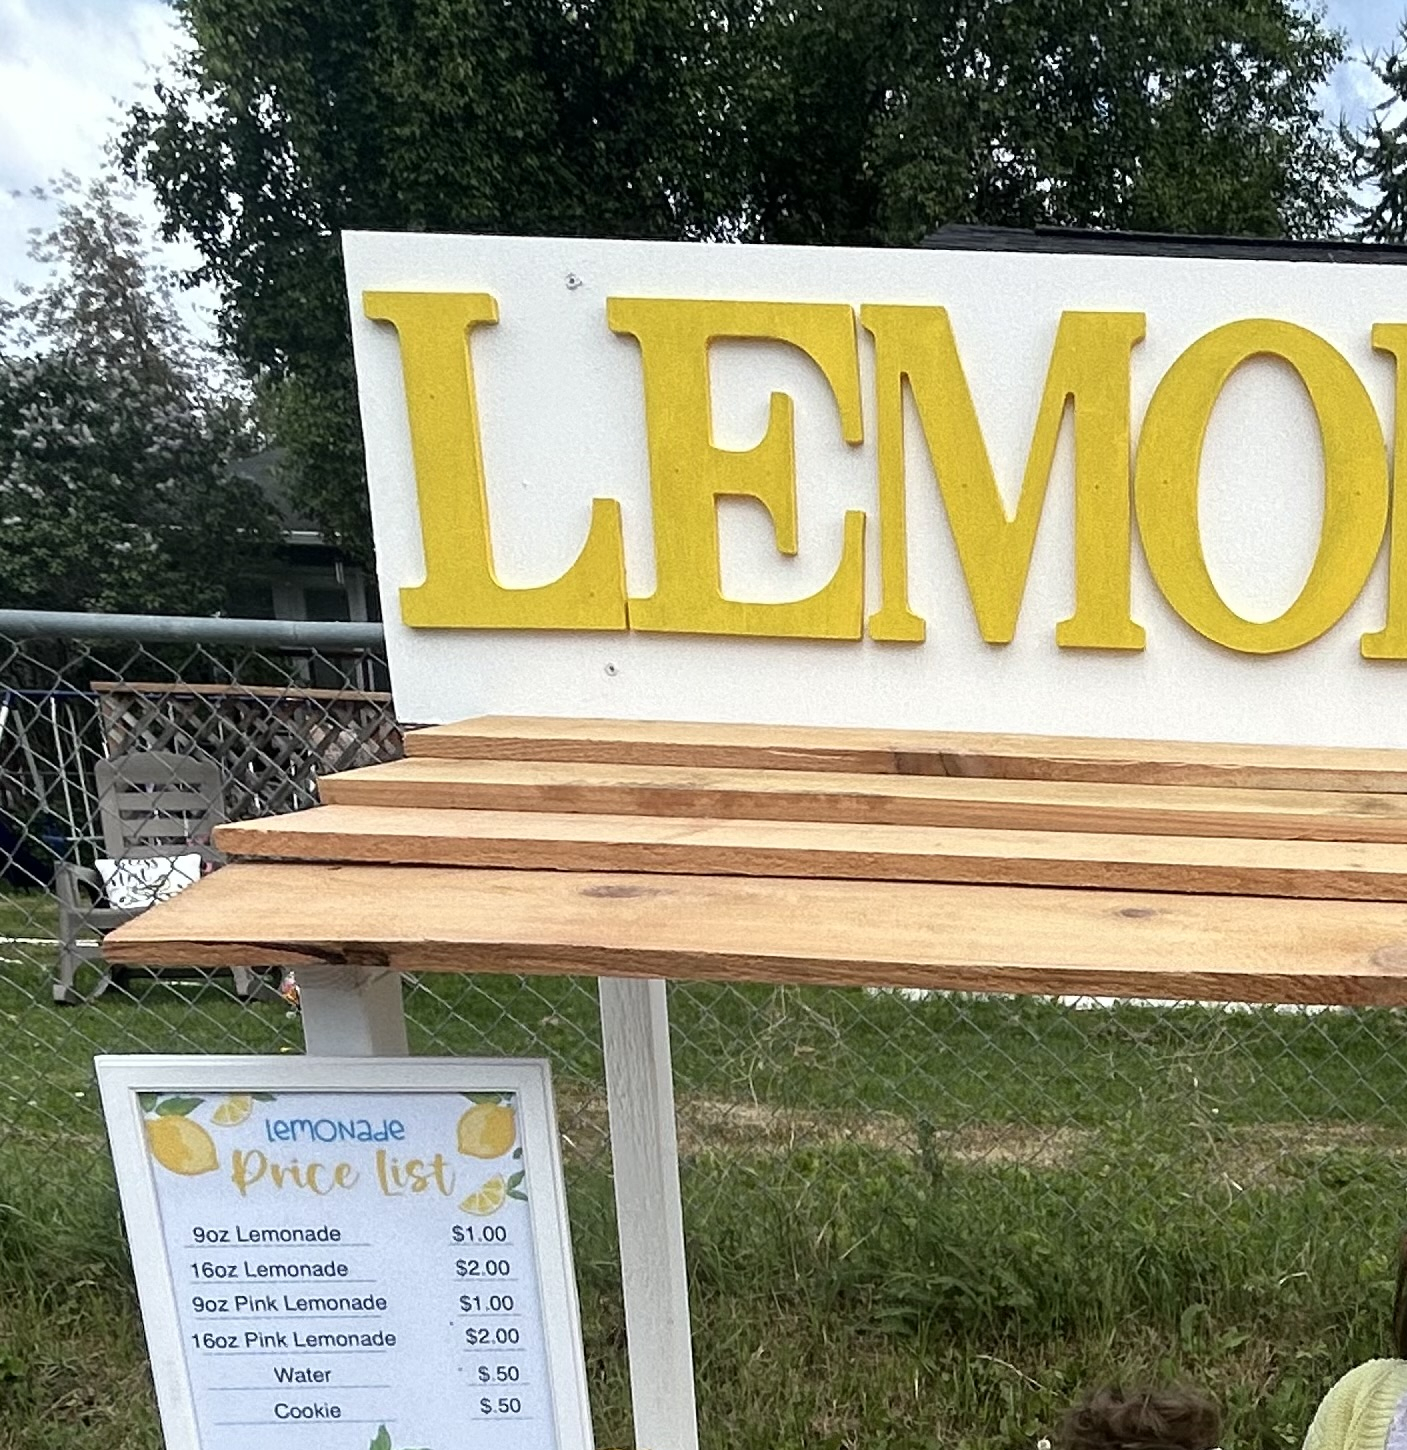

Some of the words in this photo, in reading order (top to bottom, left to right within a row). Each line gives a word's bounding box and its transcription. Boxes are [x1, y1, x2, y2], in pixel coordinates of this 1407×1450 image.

[231, 1149, 360, 1197] Price
[192, 1226, 231, 1243] 9oz
[236, 1224, 342, 1243] Lemonade
[451, 1224, 507, 1243] $1.00
[190, 1261, 239, 1279] 16oz
[243, 1260, 349, 1278] Lemonade
[455, 1258, 511, 1277] $2.00
[191, 1296, 229, 1313] 9oz
[234, 1295, 279, 1312] Pink
[283, 1294, 388, 1312] Lemonade
[459, 1294, 515, 1313] $1.00
[192, 1332, 240, 1350] 16oz
[244, 1331, 289, 1349] Pink
[292, 1330, 397, 1348] Lemonade
[465, 1327, 520, 1346] $2.00
[273, 1366, 332, 1384] Water
[477, 1365, 520, 1383] $.50
[273, 1402, 342, 1420] Cookie
[479, 1397, 522, 1415] $.50
